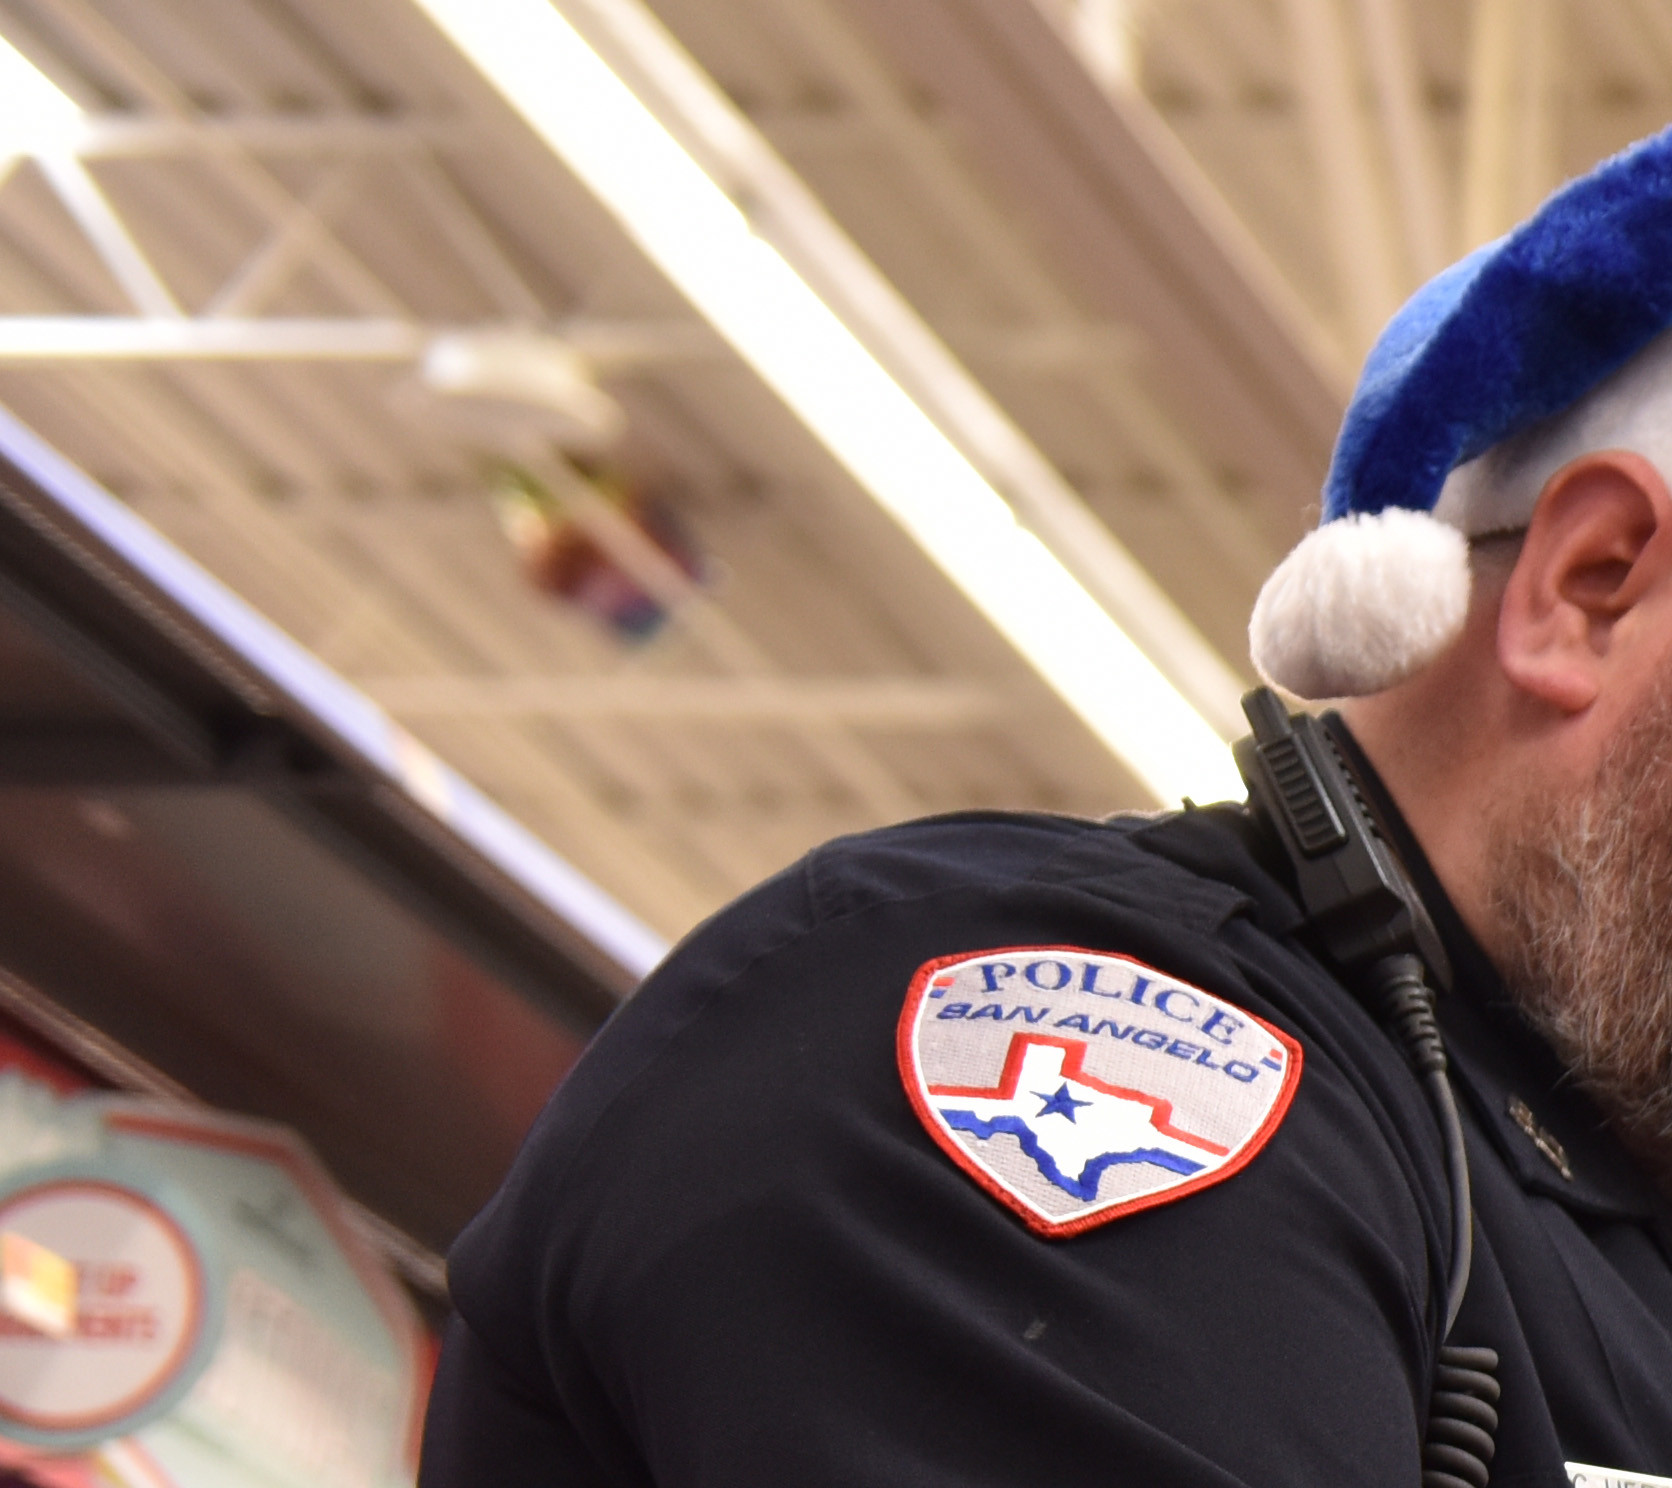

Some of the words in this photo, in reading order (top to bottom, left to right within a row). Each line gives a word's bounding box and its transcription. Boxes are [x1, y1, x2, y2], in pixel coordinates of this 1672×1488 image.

[937, 1002, 1050, 1023] SAN
[1055, 1014, 1261, 1083] ANGELO
[980, 960, 1246, 1045] POLICE
